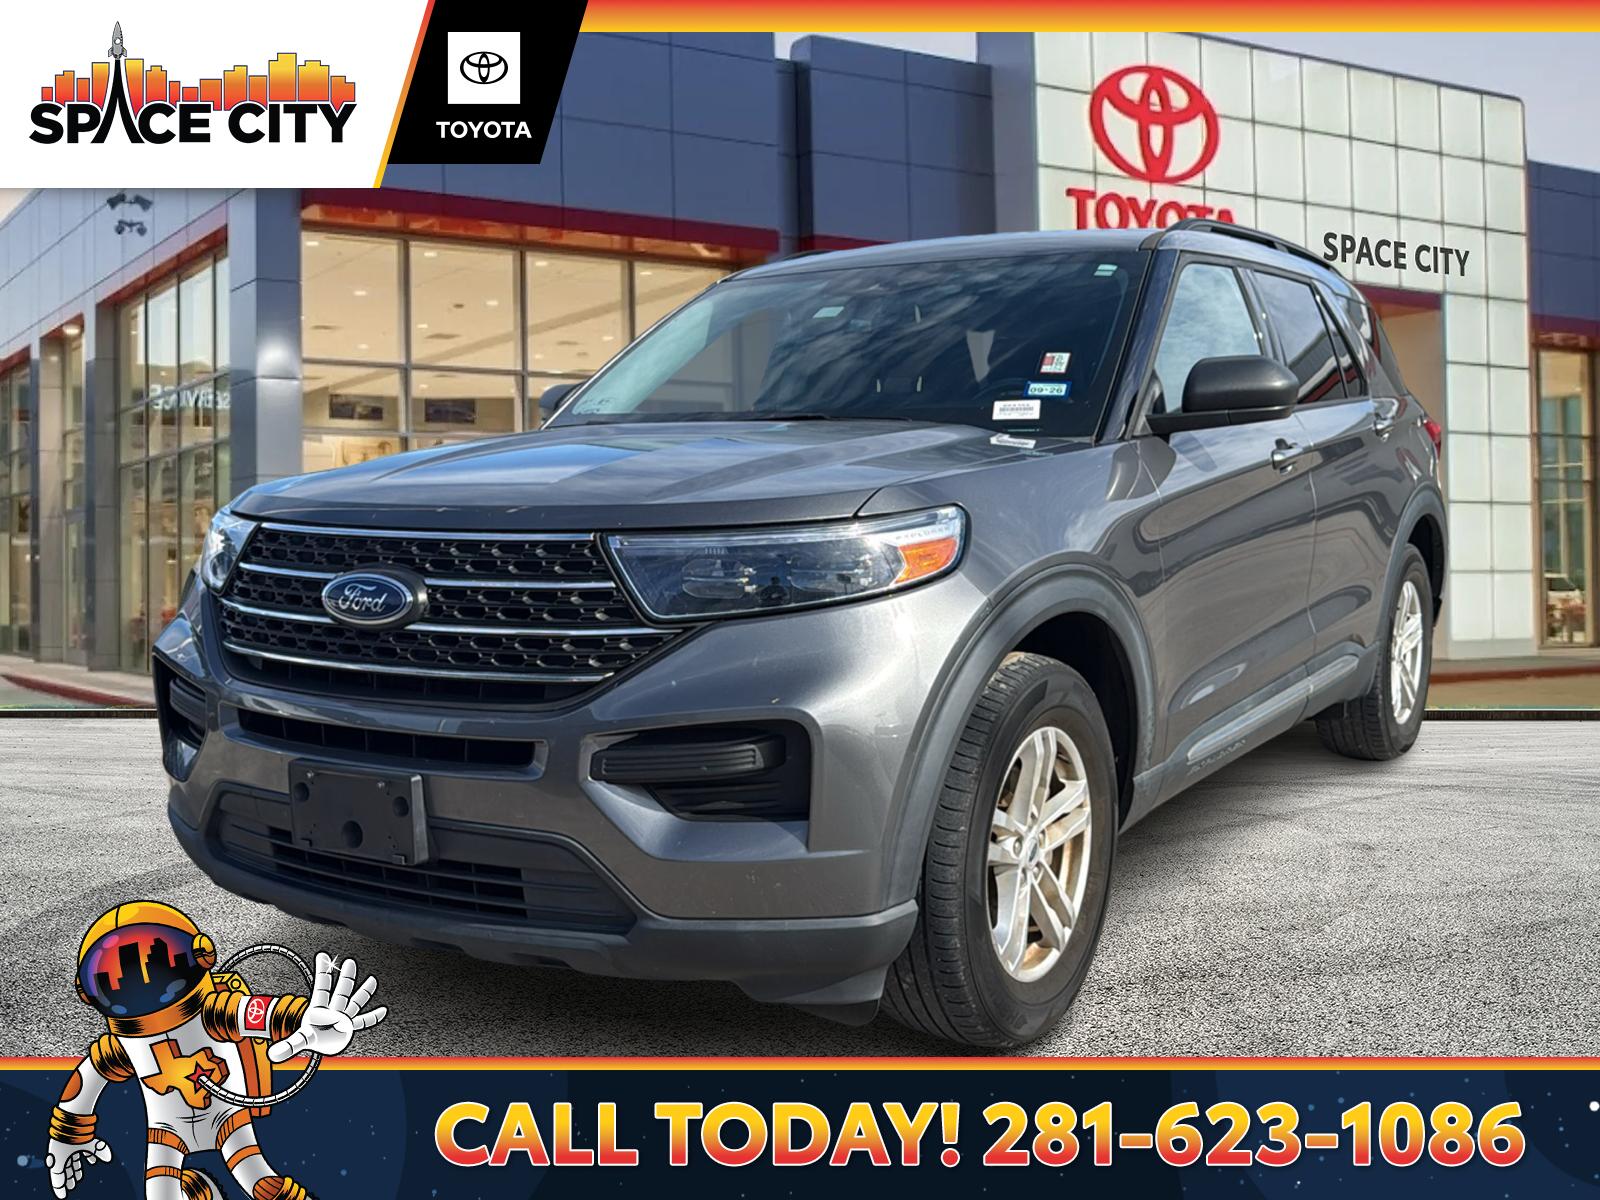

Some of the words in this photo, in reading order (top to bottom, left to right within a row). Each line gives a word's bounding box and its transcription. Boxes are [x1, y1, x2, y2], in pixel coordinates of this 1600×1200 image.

[1323, 231, 1407, 270] SPACE
[1414, 244, 1471, 277] CITY
[338, 583, 388, 612] Ford
